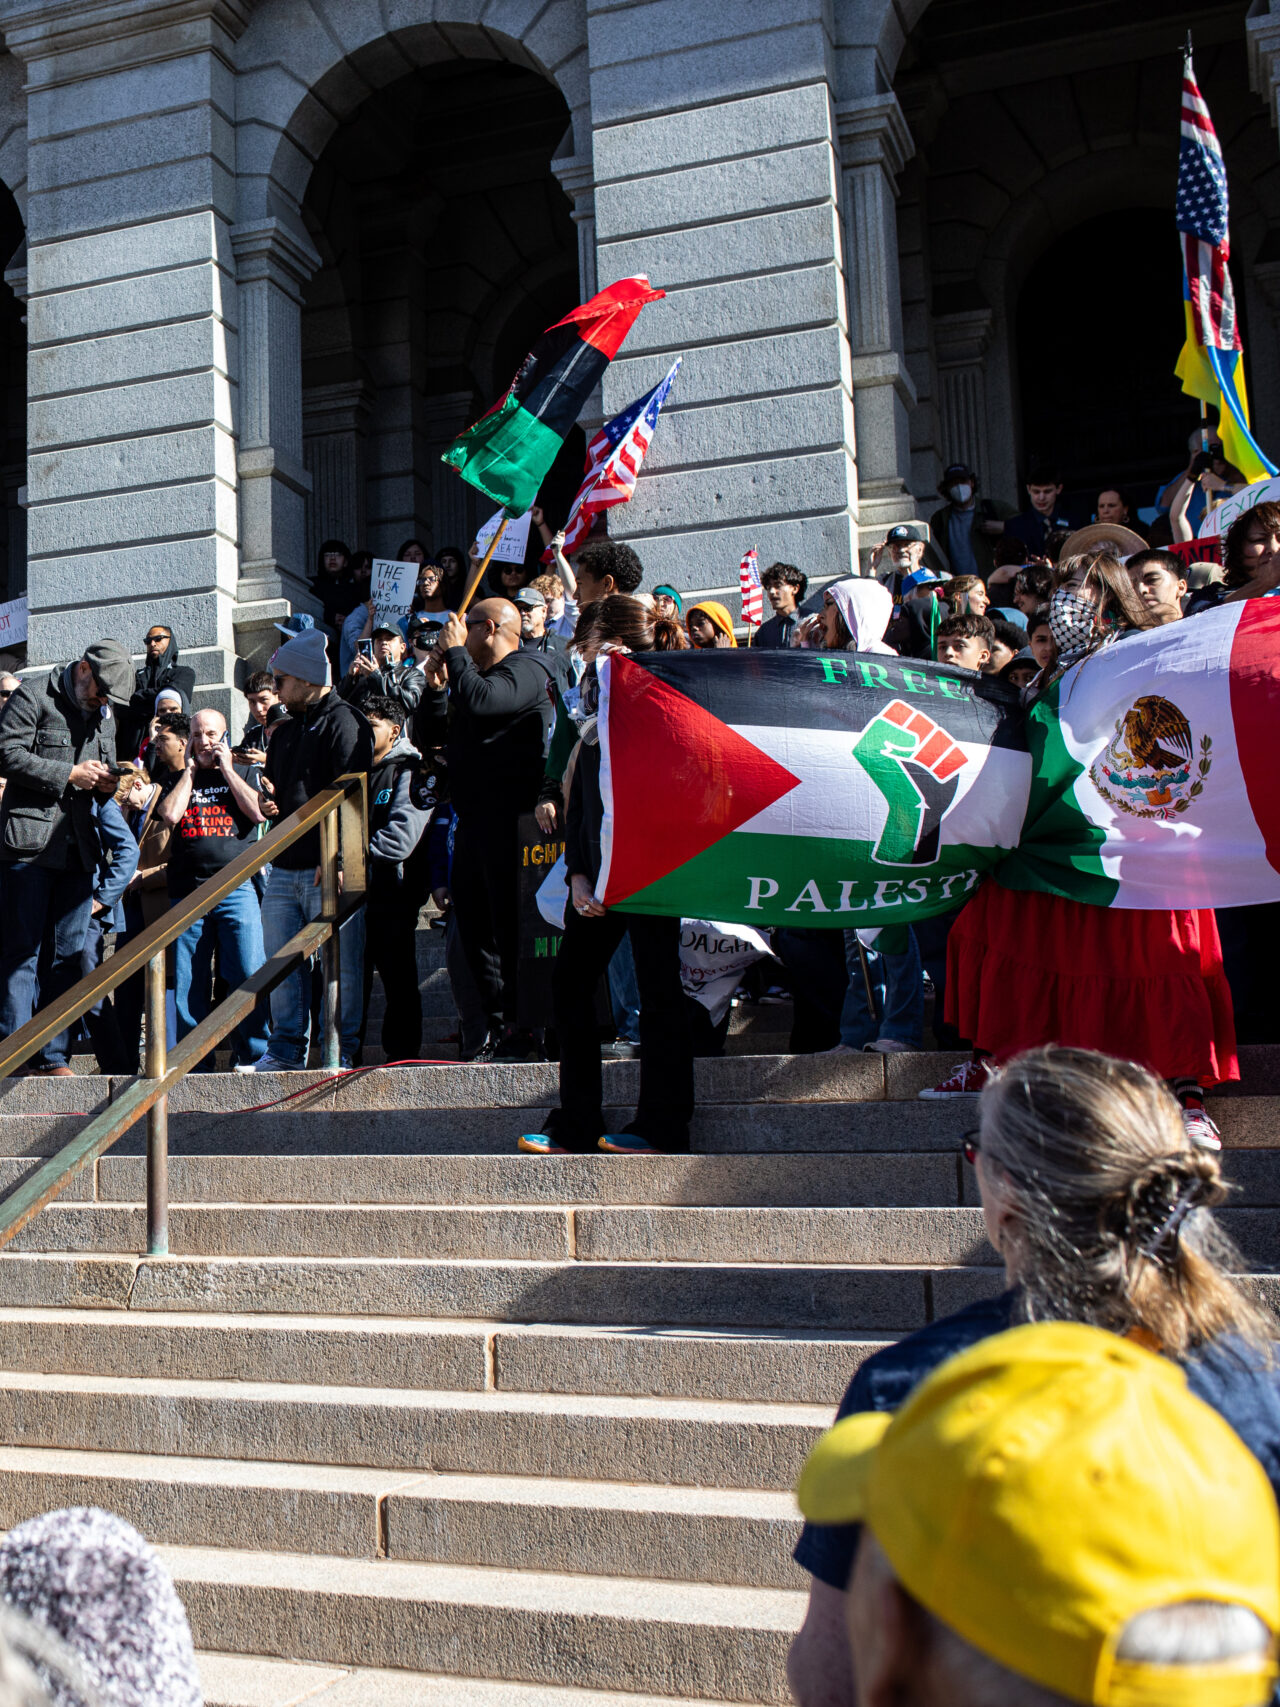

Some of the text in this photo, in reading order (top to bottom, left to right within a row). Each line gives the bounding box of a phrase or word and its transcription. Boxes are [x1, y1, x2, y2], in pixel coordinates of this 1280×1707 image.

[376, 563, 405, 580] THE
[378, 581, 399, 594] USA
[372, 590, 391, 602] WAS
[816, 657, 970, 702] FREE
[204, 786, 230, 795] story
[192, 795, 219, 804] short.
[184, 805, 228, 817] DO NOT
[181, 827, 235, 838] COMPLY.
